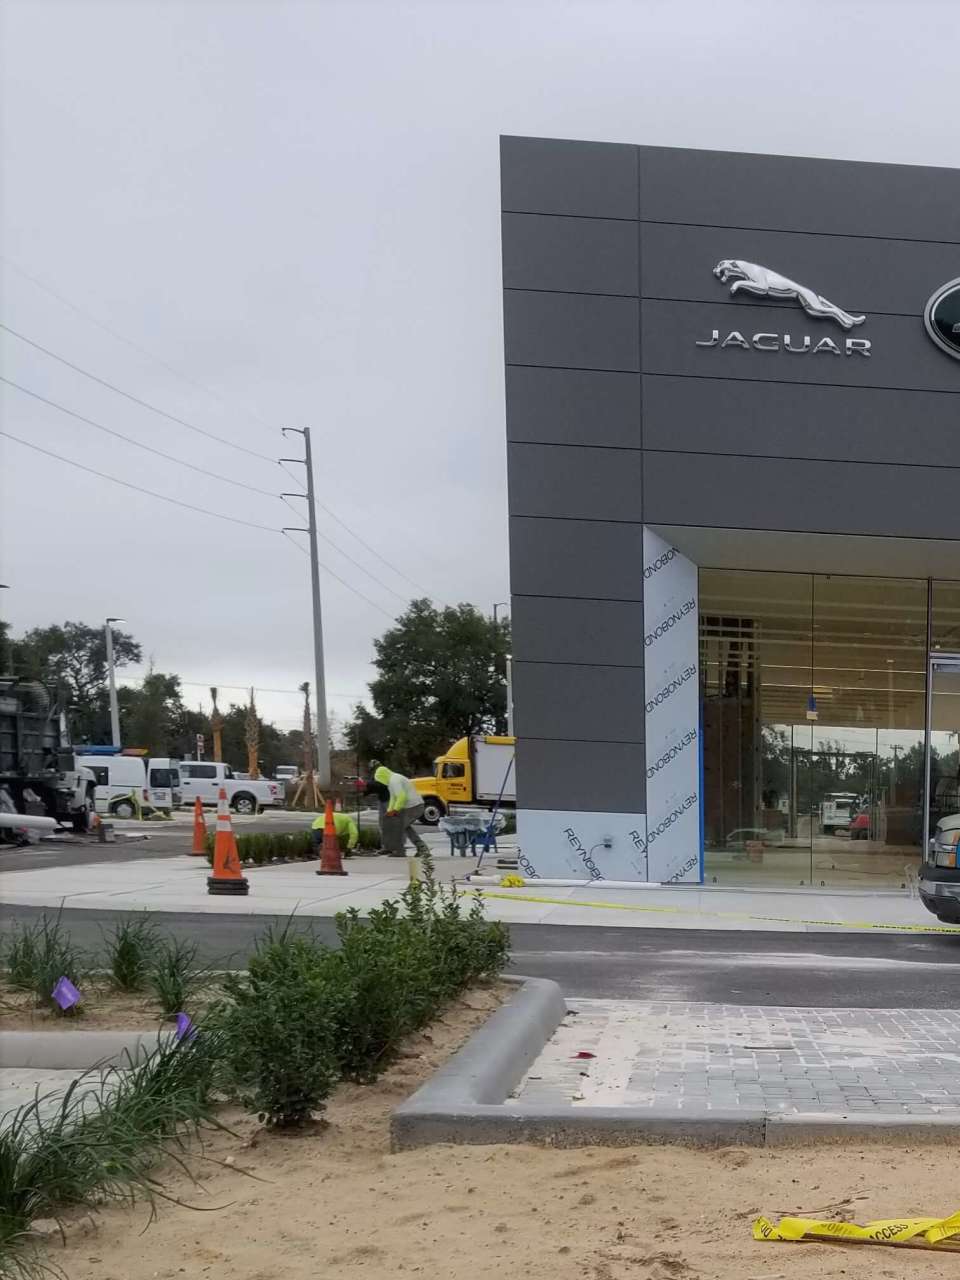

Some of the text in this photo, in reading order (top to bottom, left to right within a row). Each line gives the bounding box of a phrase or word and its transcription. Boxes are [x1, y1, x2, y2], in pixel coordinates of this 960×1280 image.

[696, 329, 872, 357] JAGUAR
[645, 663, 697, 713] REYNOBOND
[645, 728, 697, 779] REYNOBOND
